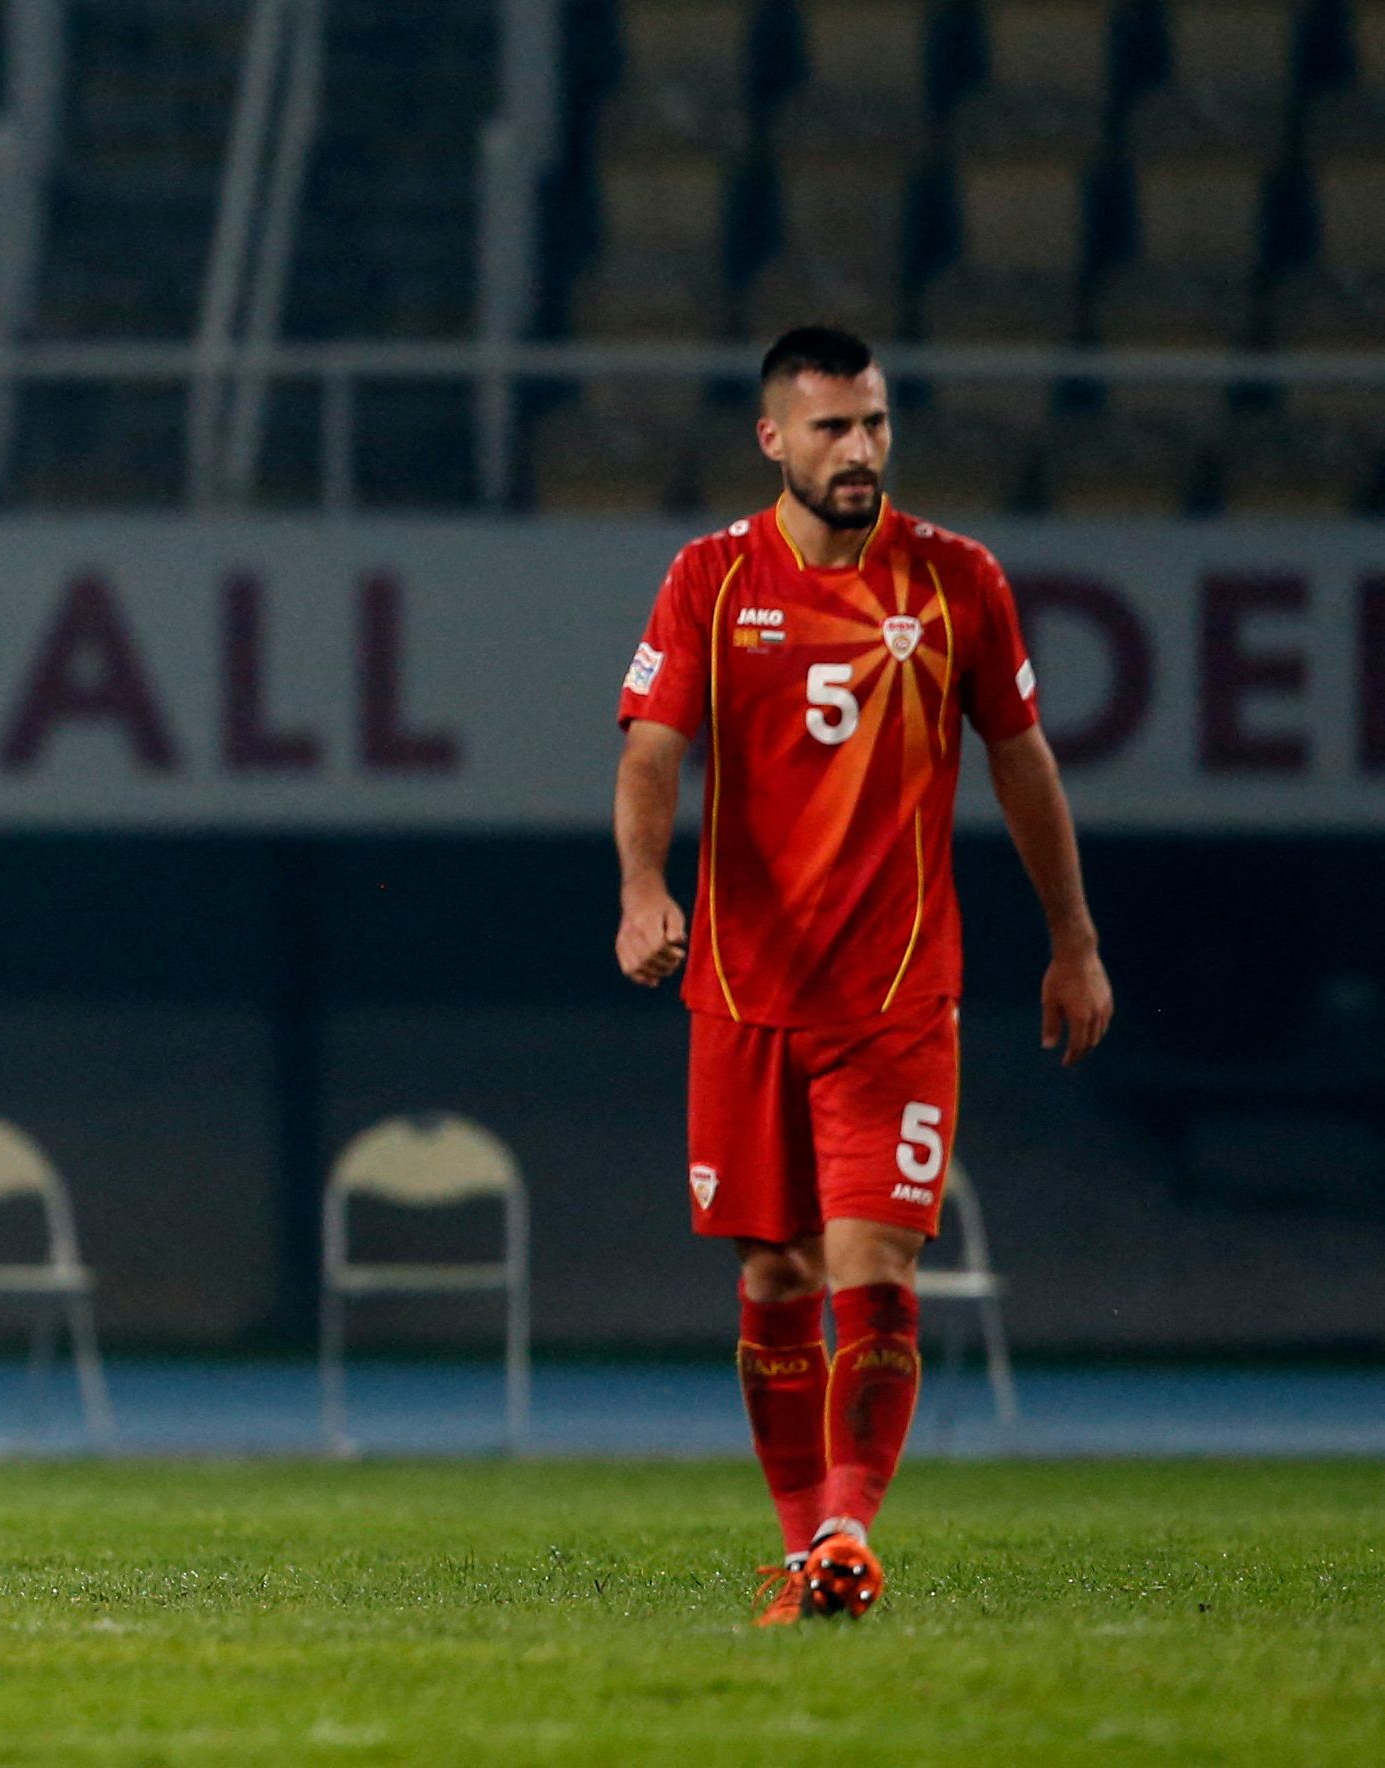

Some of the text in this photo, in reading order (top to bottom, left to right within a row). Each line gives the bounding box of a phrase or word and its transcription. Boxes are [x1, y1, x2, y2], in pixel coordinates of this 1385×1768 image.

[737, 608, 784, 627] JAKO
[806, 663, 859, 745] 5
[896, 1101, 943, 1181] 5
[891, 1183, 934, 1205] JAKO
